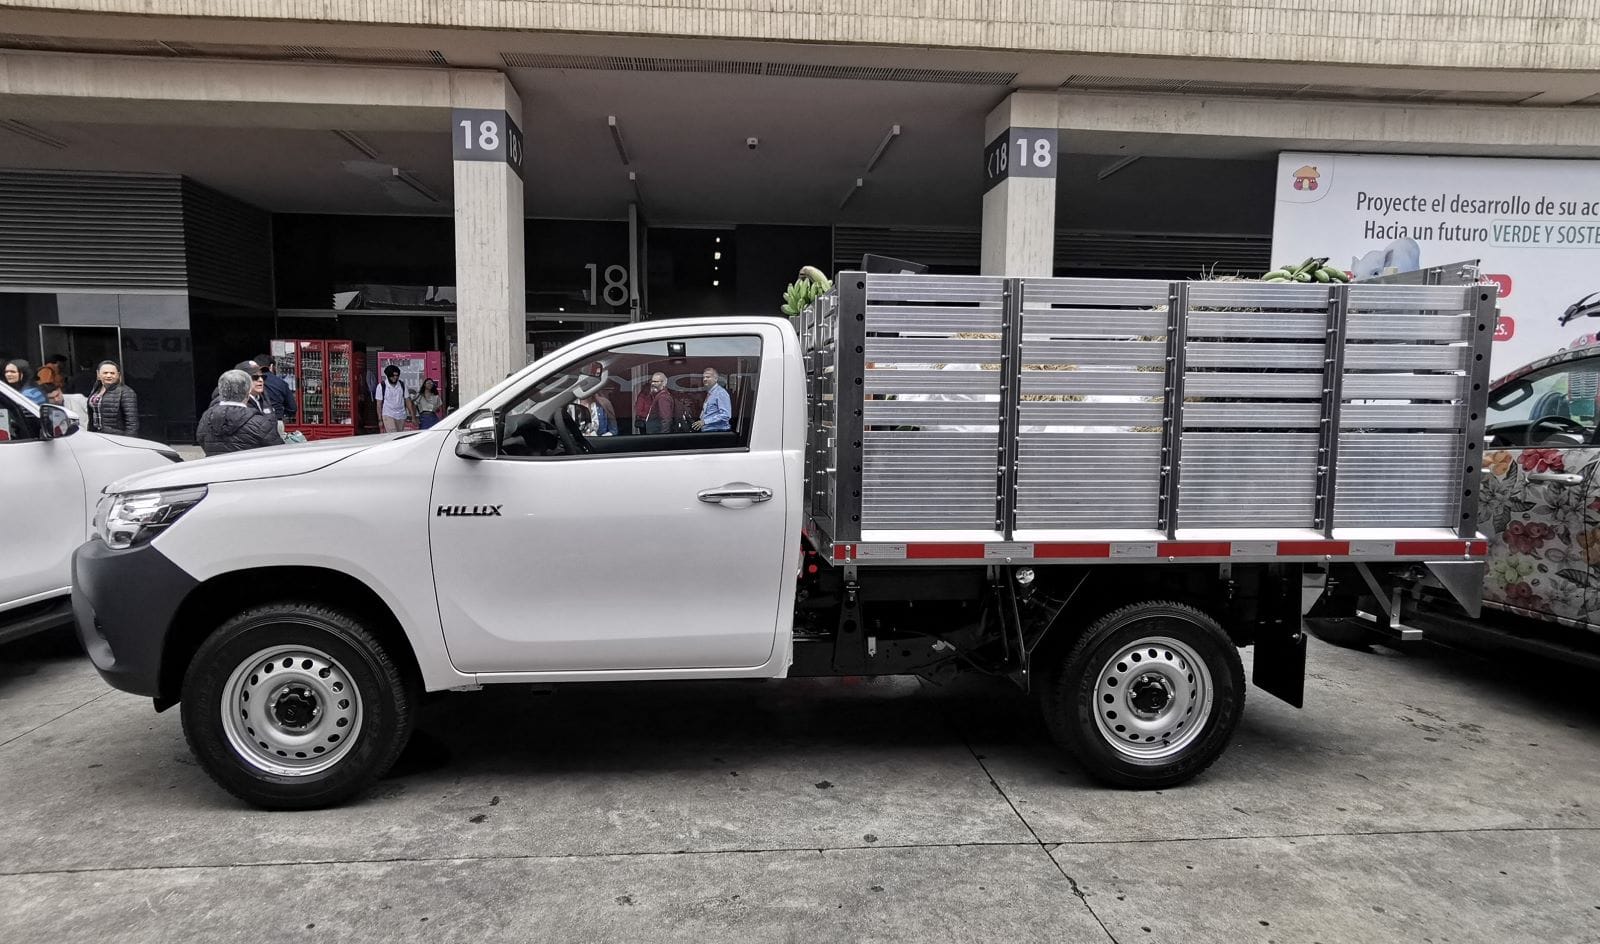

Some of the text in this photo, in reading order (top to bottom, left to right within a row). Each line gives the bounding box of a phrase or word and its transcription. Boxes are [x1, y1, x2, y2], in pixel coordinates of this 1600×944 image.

[459, 120, 499, 151] 18
[508, 129, 518, 164] 18
[995, 142, 1007, 175] 18
[1016, 138, 1052, 168] 18
[1356, 191, 1600, 216] Proyecte el desarrollo de su ac
[1364, 220, 1408, 240] Hacia
[1413, 226, 1433, 241] un
[1438, 221, 1488, 242] futuro
[1493, 224, 1541, 243] VERDE
[1545, 225, 1554, 244] Y
[584, 263, 629, 306] 18
[436, 504, 504, 517] HILUX
